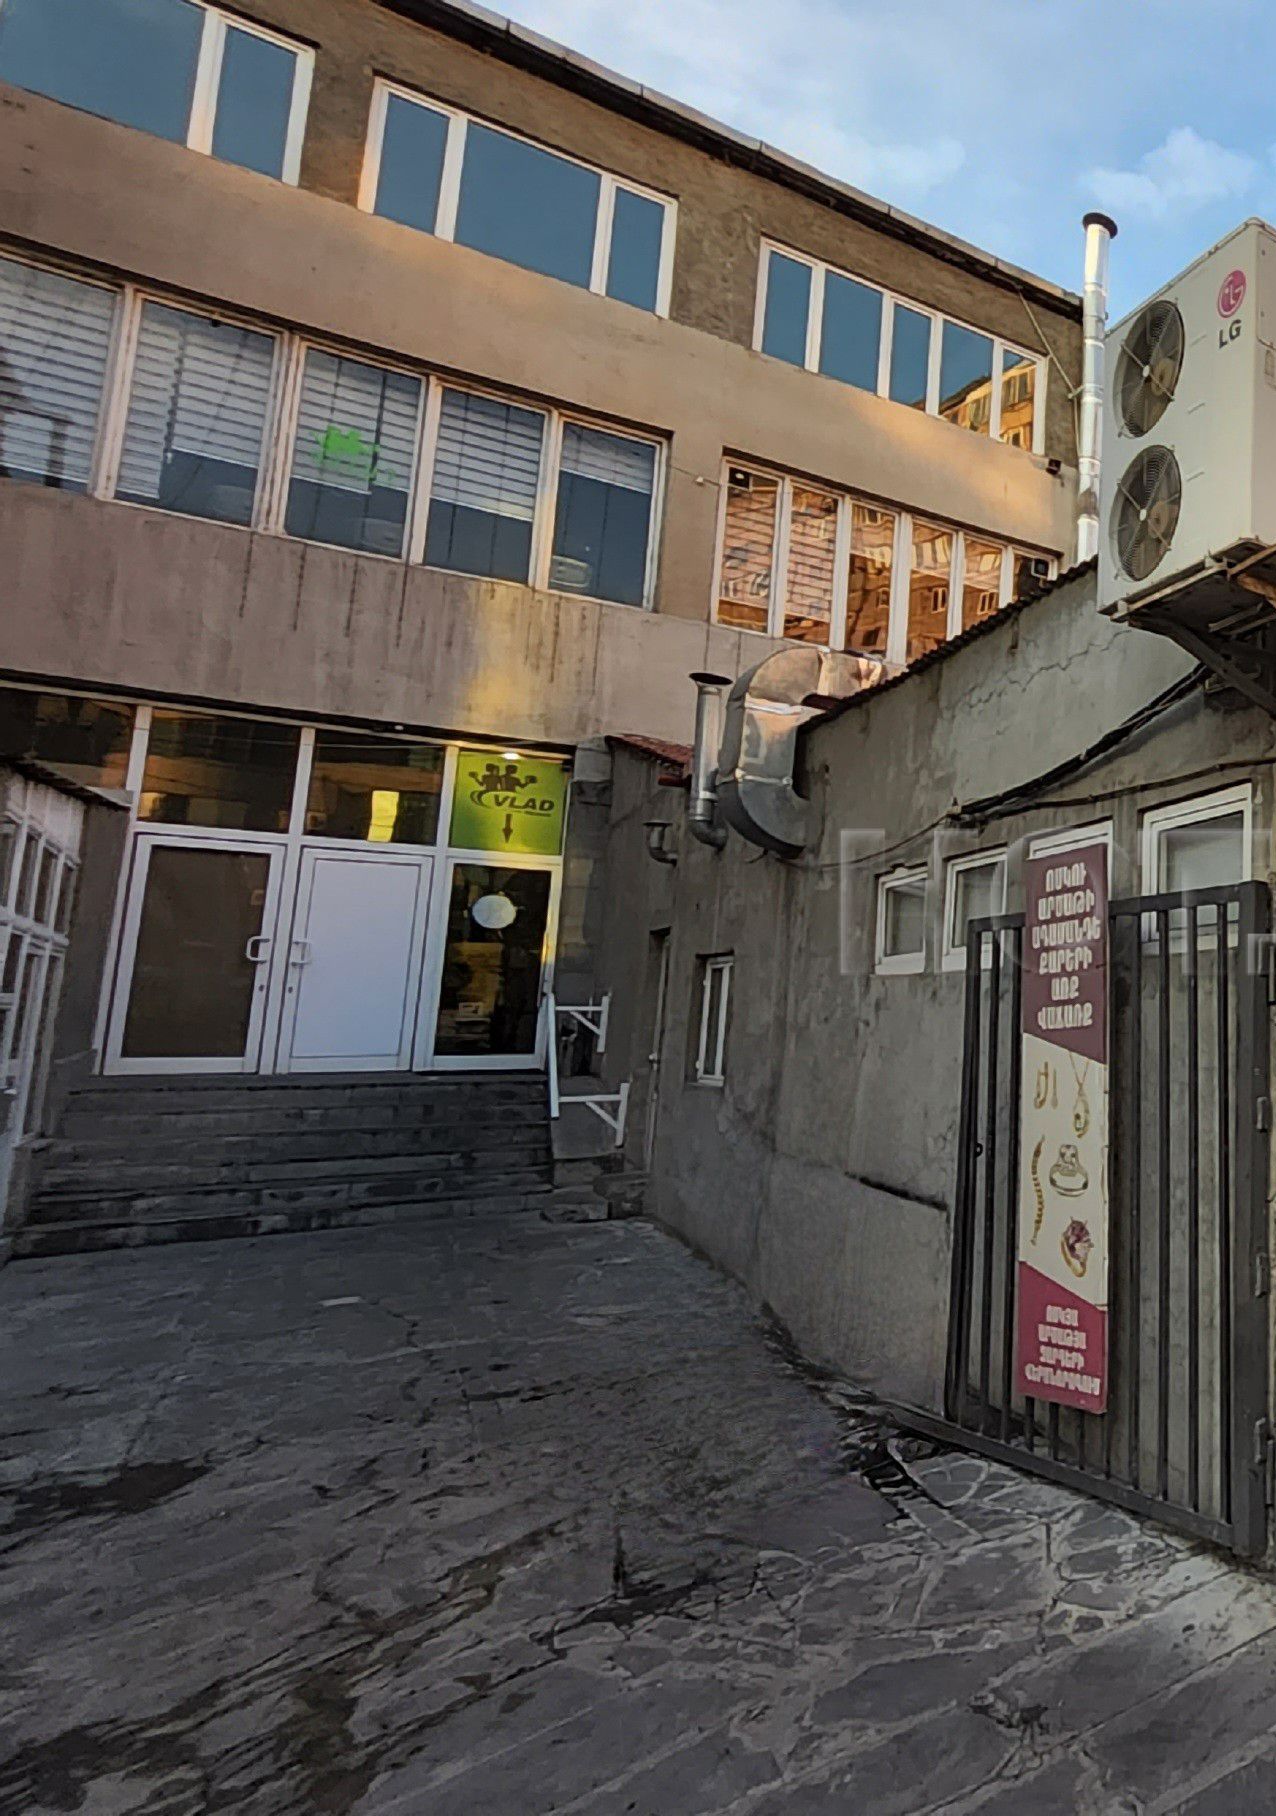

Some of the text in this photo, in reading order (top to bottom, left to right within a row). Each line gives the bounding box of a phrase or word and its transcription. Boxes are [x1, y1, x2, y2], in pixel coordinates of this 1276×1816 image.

[1219, 319, 1242, 349] LG
[494, 795, 554, 811] VLAD
[1045, 862, 1086, 892] ՈՍԿՈՒ
[1038, 889, 1094, 920] ԱՐԾԱԹԻ
[1032, 915, 1101, 950] ԱԴԱՄԱՆԴԵ
[1039, 945, 1093, 976] ՔԱՐԵՐԻ
[1051, 975, 1079, 1001] ԱՌՔ
[1037, 1002, 1093, 1030] ՎԱՃԱՌՔ
